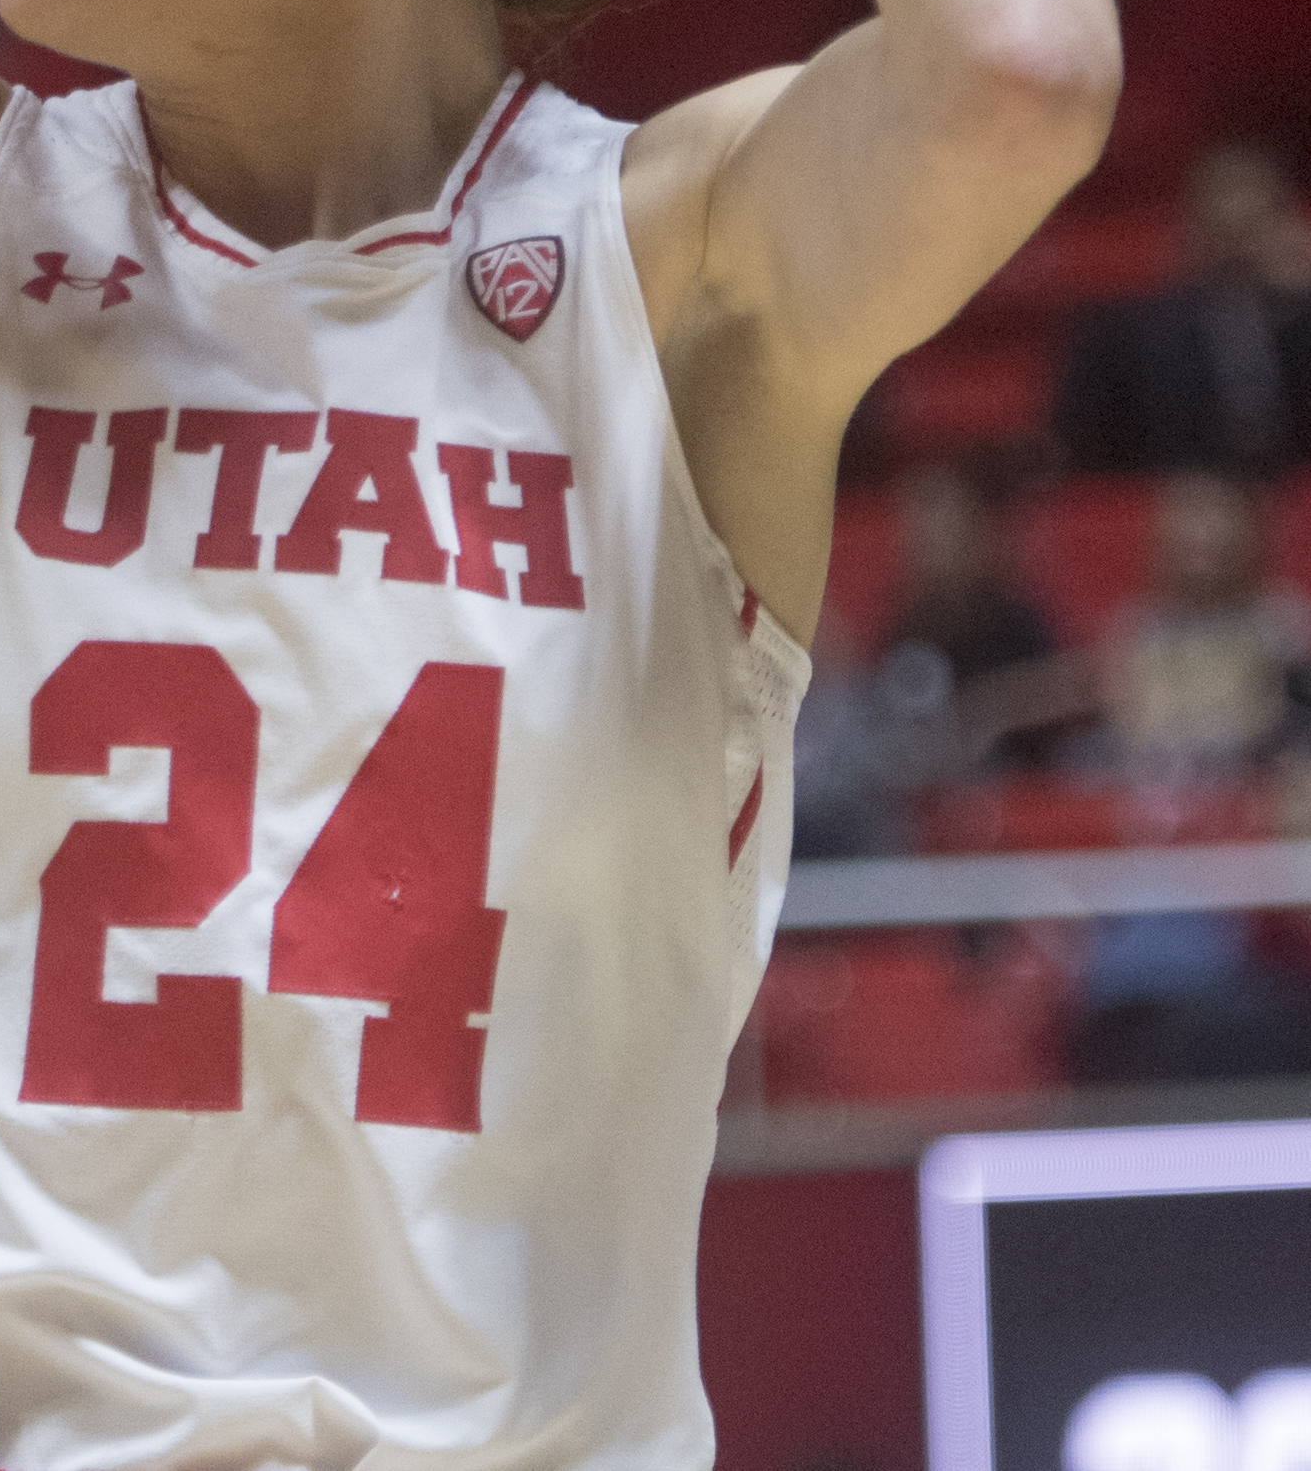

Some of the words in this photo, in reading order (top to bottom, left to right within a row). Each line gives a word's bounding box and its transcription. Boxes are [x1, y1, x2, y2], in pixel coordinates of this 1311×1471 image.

[471, 239, 558, 306] PAC
[495, 279, 542, 322] 12
[15, 405, 586, 611] UTAH
[18, 640, 508, 1134] 24
